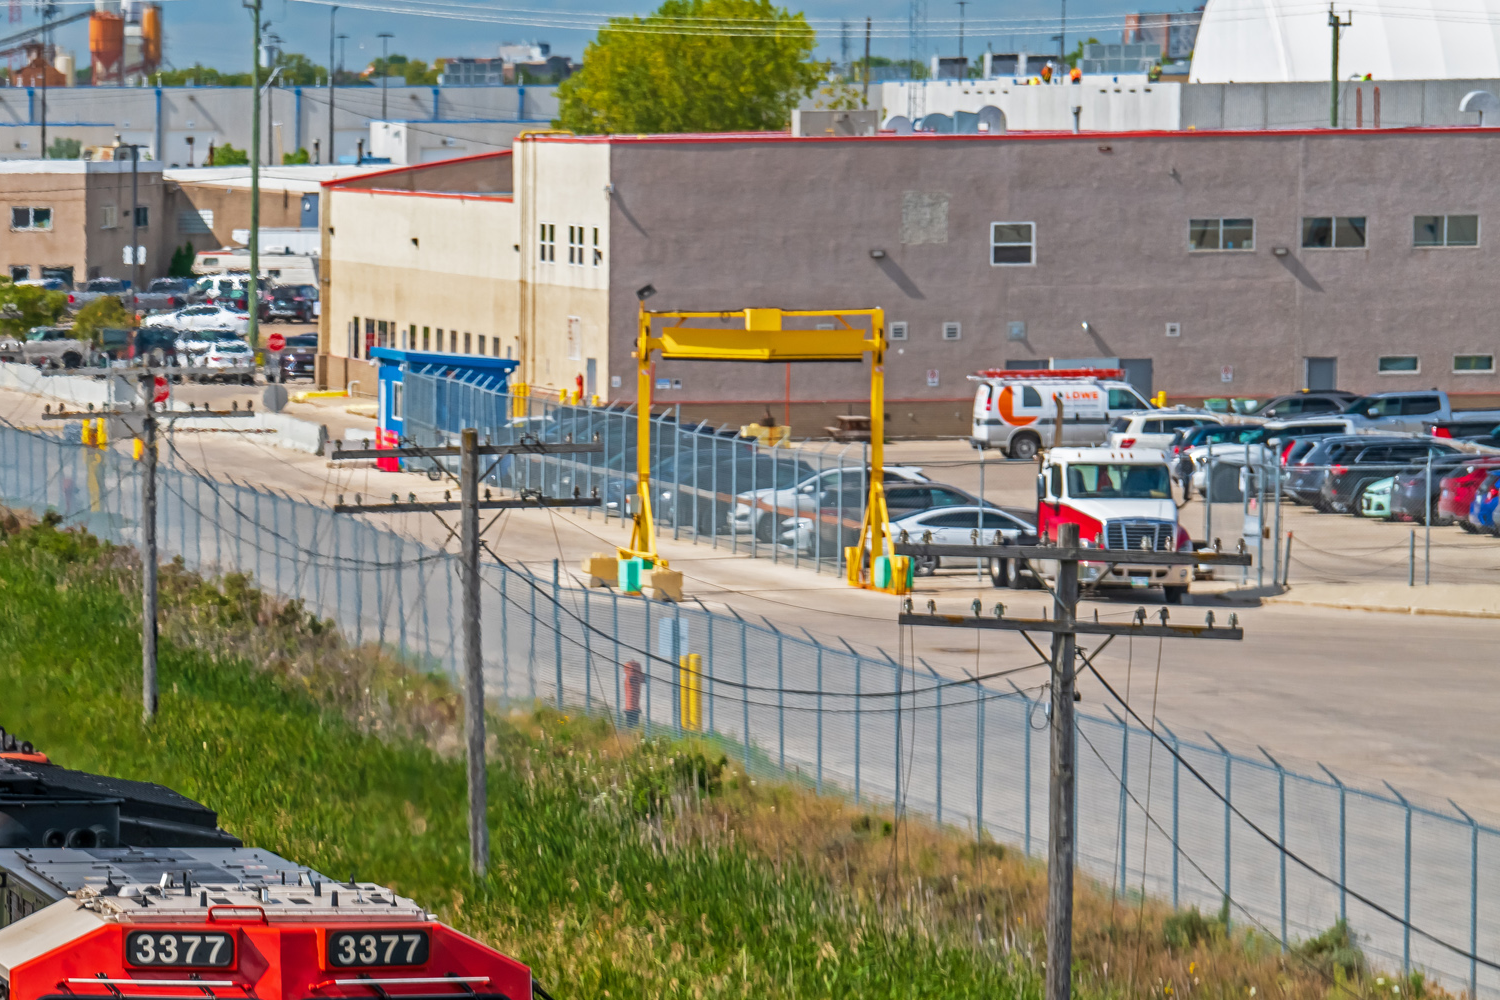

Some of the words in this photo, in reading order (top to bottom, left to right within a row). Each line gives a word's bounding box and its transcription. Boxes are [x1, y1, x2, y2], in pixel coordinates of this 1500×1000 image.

[1065, 390, 1099, 400] LOWE
[136, 934, 226, 965] 3377
[338, 934, 422, 965] 3377
